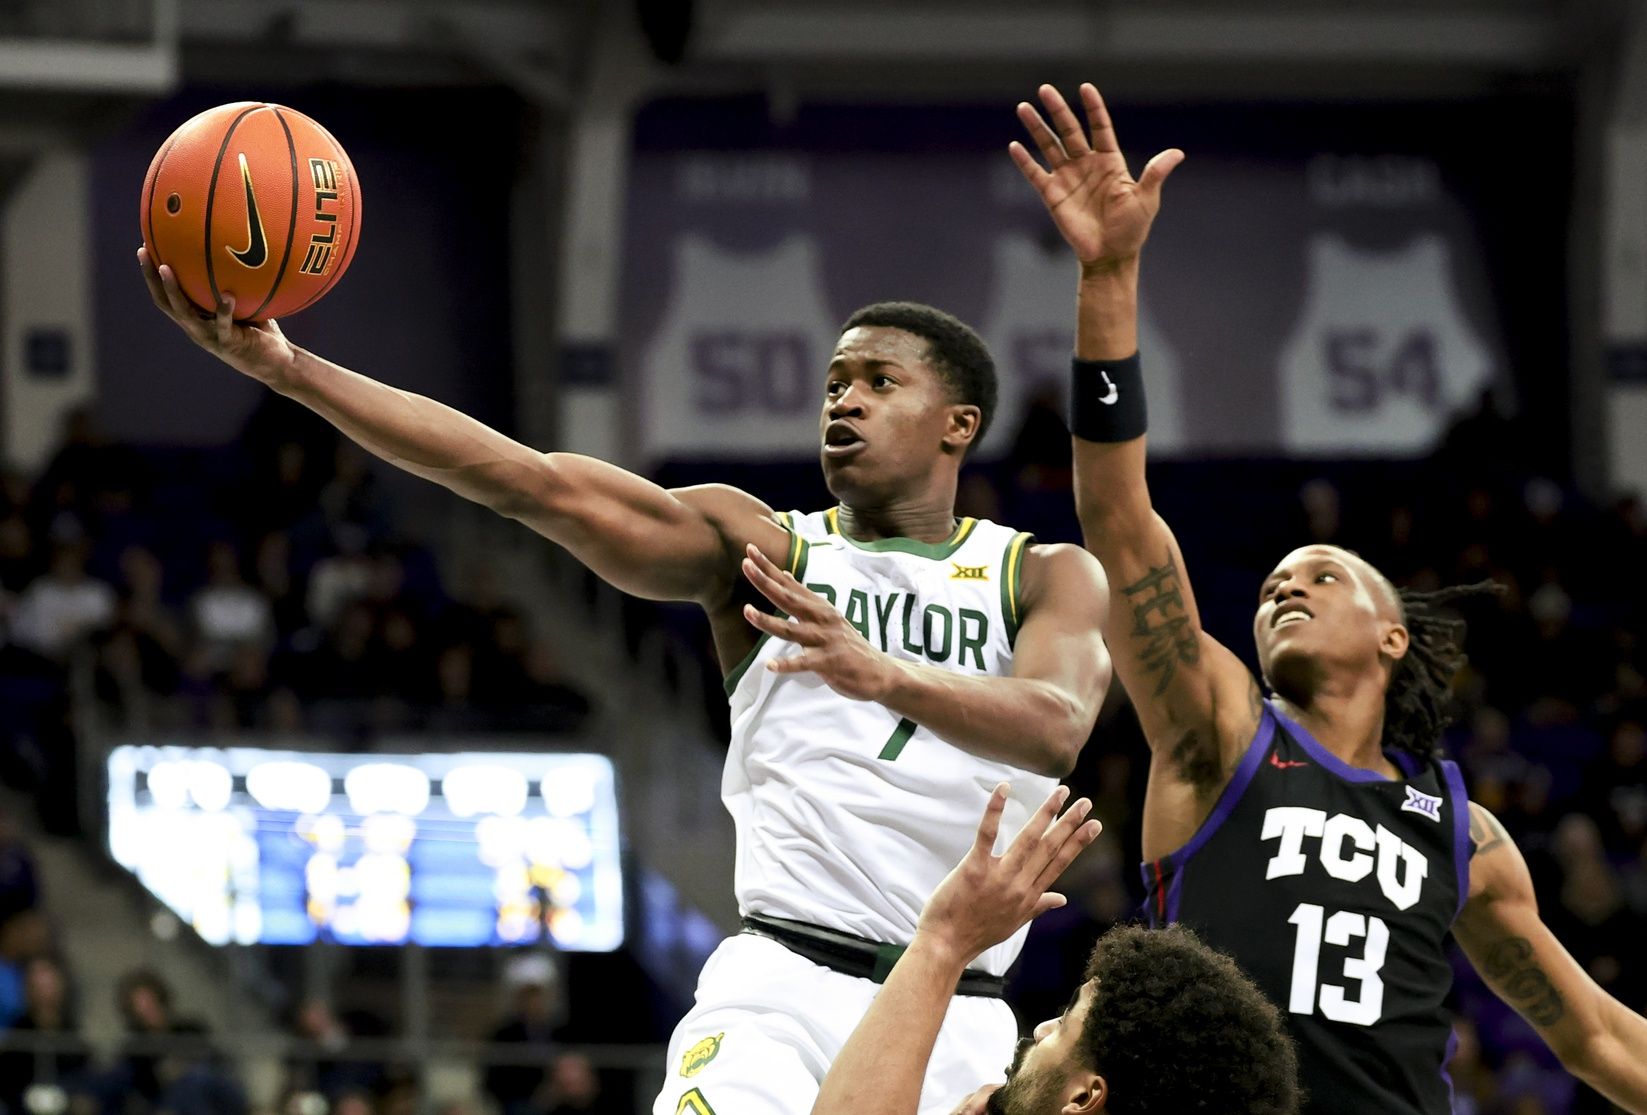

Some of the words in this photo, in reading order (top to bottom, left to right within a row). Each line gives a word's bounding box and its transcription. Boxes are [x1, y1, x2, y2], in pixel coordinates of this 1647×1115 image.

[299, 158, 338, 276] ELITE
[690, 329, 812, 414] 50
[1323, 325, 1441, 414] 54
[1406, 789, 1438, 817] XII
[1260, 806, 1428, 911] TCU
[1287, 902, 1390, 1026] 13
